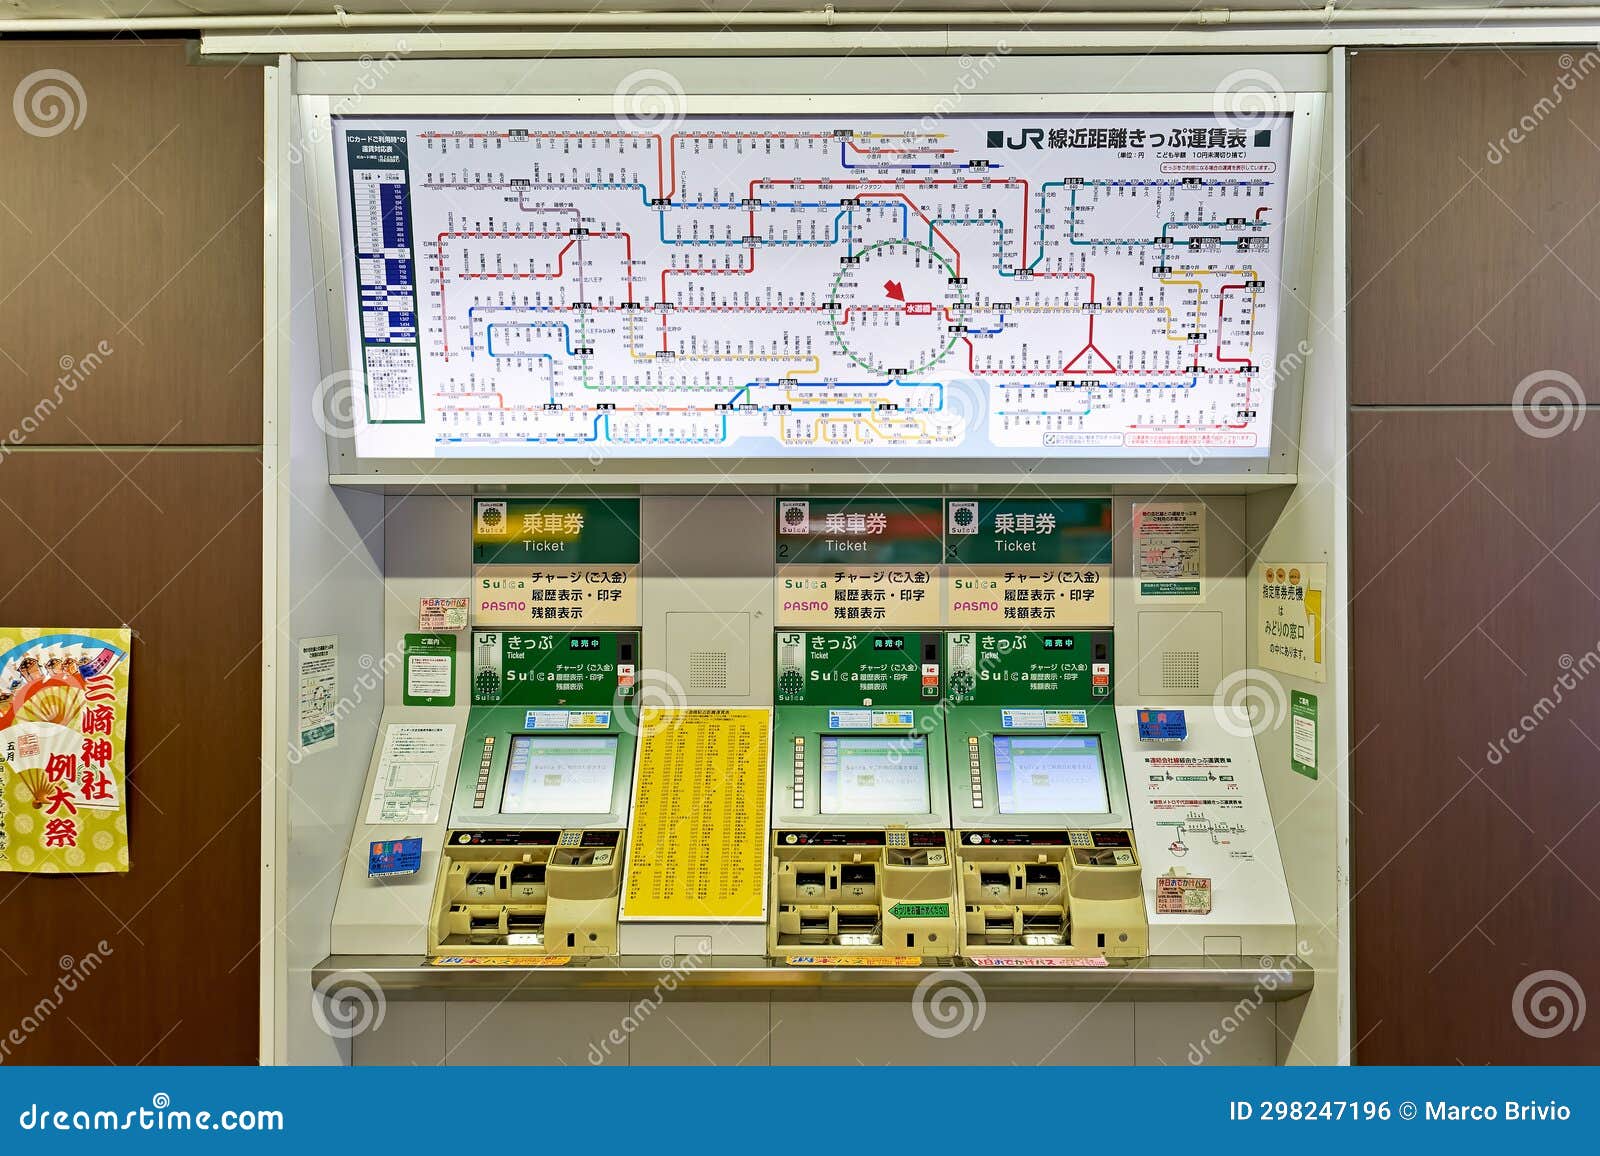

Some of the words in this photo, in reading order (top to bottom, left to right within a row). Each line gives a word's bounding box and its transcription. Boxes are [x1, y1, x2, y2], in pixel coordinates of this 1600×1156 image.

[523, 513, 585, 535] 乗車券
[825, 513, 887, 535] 乗車券
[994, 513, 1056, 535] 乗車券
[479, 544, 485, 557] 1
[523, 540, 565, 551] Ticket
[779, 544, 789, 557] 2
[825, 540, 867, 551] Ticket
[949, 544, 958, 558] 3
[994, 540, 1036, 551] Ticket
[482, 579, 525, 589] Suica
[785, 579, 827, 589] Suica
[955, 579, 997, 589] Suica
[531, 589, 622, 601] 履歴表示・印字
[834, 589, 925, 601] 履歴表示・印字
[1004, 589, 1095, 601] 履歴表示・印字
[1262, 584, 1304, 601] 指定席券売機
[481, 601, 526, 611] PASMO
[784, 601, 829, 611] PASMO
[954, 601, 999, 611] PASMO
[1278, 605, 1284, 616] は
[531, 607, 583, 619] 残額表示
[834, 607, 886, 619] 残額表示
[1004, 607, 1056, 619] 残額表示
[1265, 620, 1305, 640] みどりの窓口
[507, 635, 553, 650] きっぷ
[811, 635, 857, 650] きっぷ
[507, 651, 525, 659] Ticket
[811, 651, 829, 659] Ticket
[506, 670, 555, 681] Suica
[810, 670, 859, 681] Suica
[980, 670, 1029, 681] Suica
[5, 741, 15, 762] 五月
[44, 752, 78, 848] 例大祭
